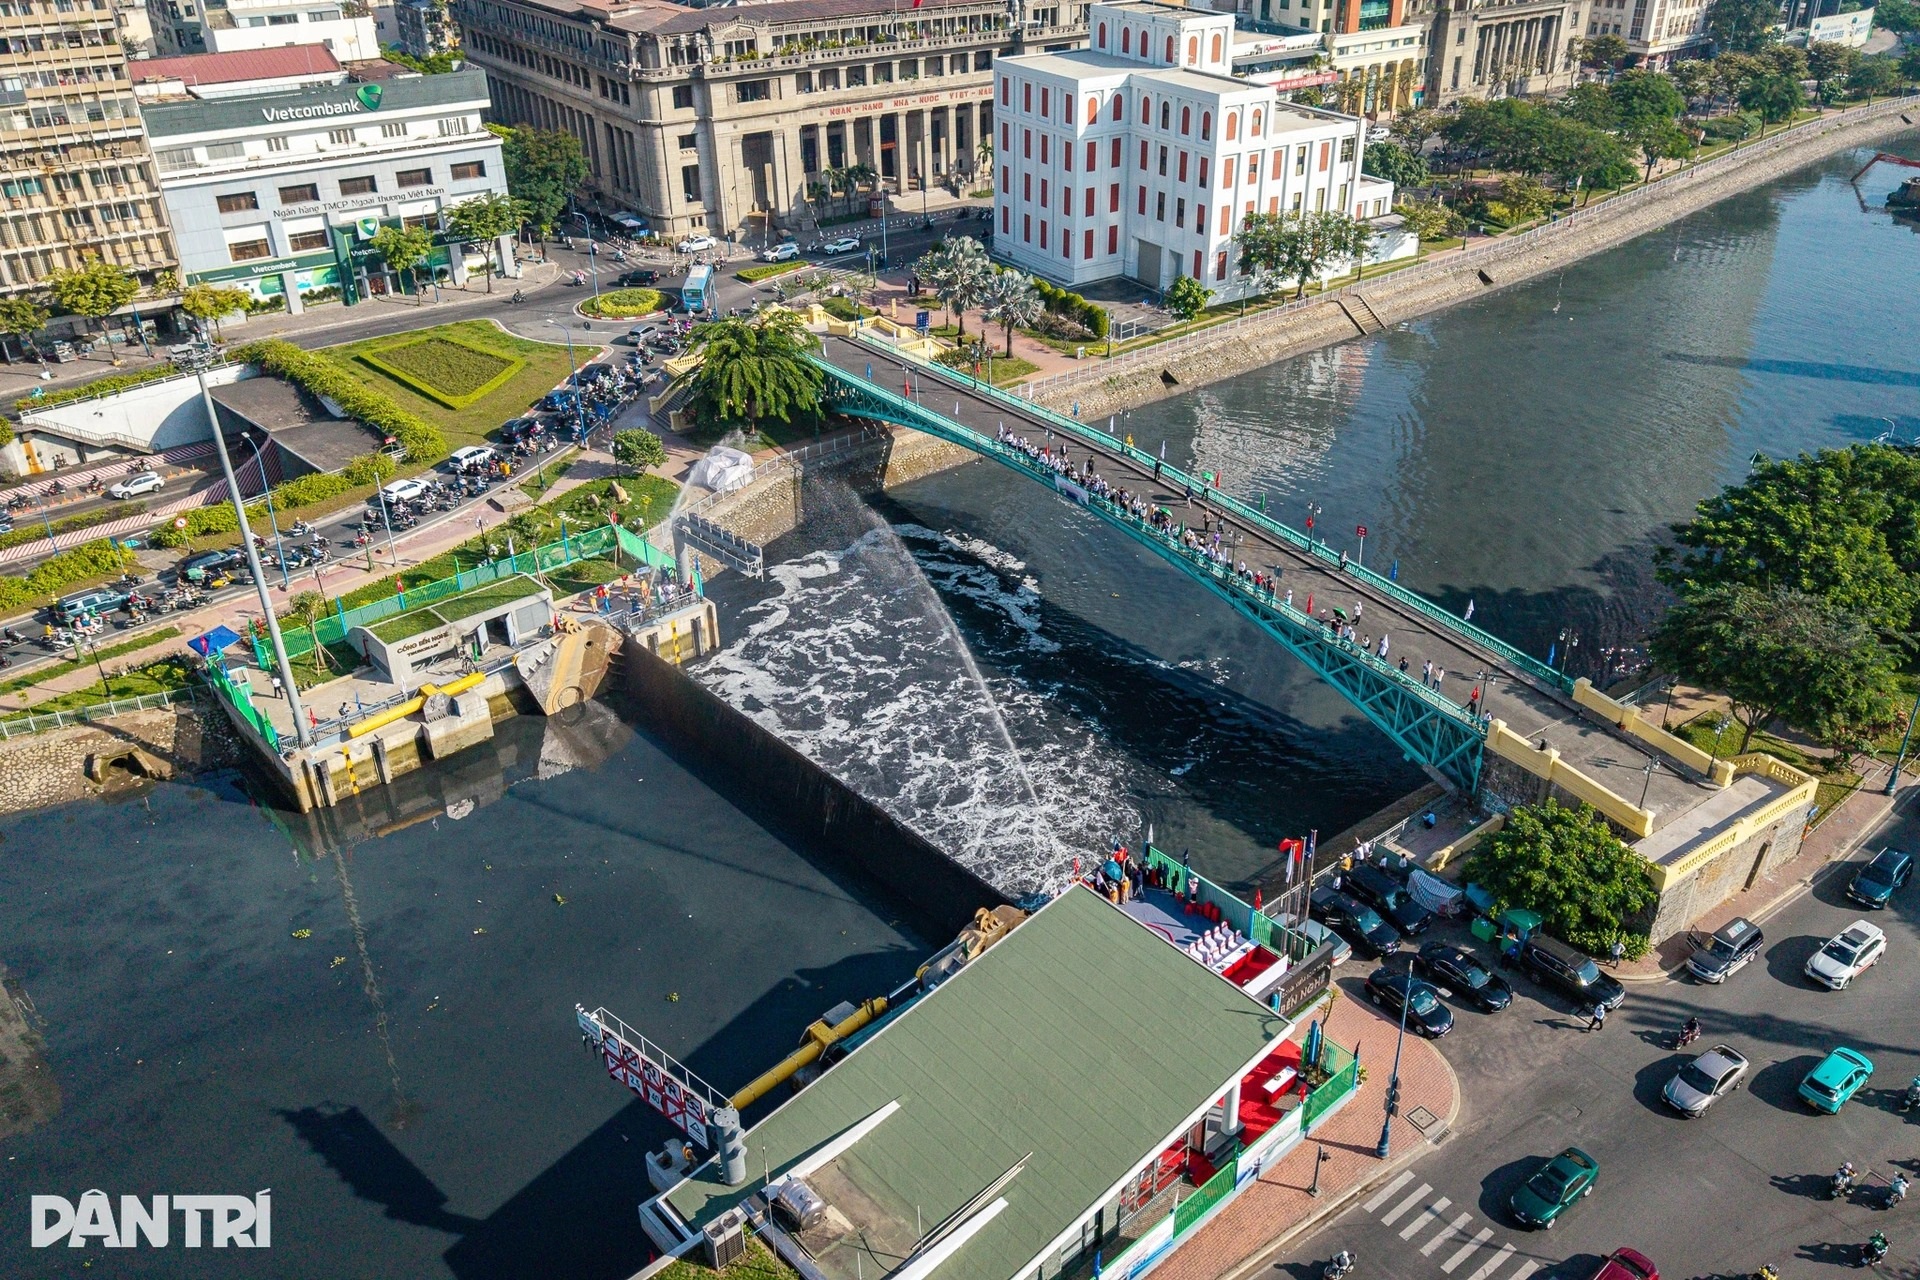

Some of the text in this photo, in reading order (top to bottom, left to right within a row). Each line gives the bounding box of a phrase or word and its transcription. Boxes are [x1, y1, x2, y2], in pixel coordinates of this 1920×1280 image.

[262, 99, 360, 122] Vietcombank
[322, 200, 348, 211] TMCP
[426, 187, 445, 196] Nam
[252, 261, 297, 273] Vietcombank
